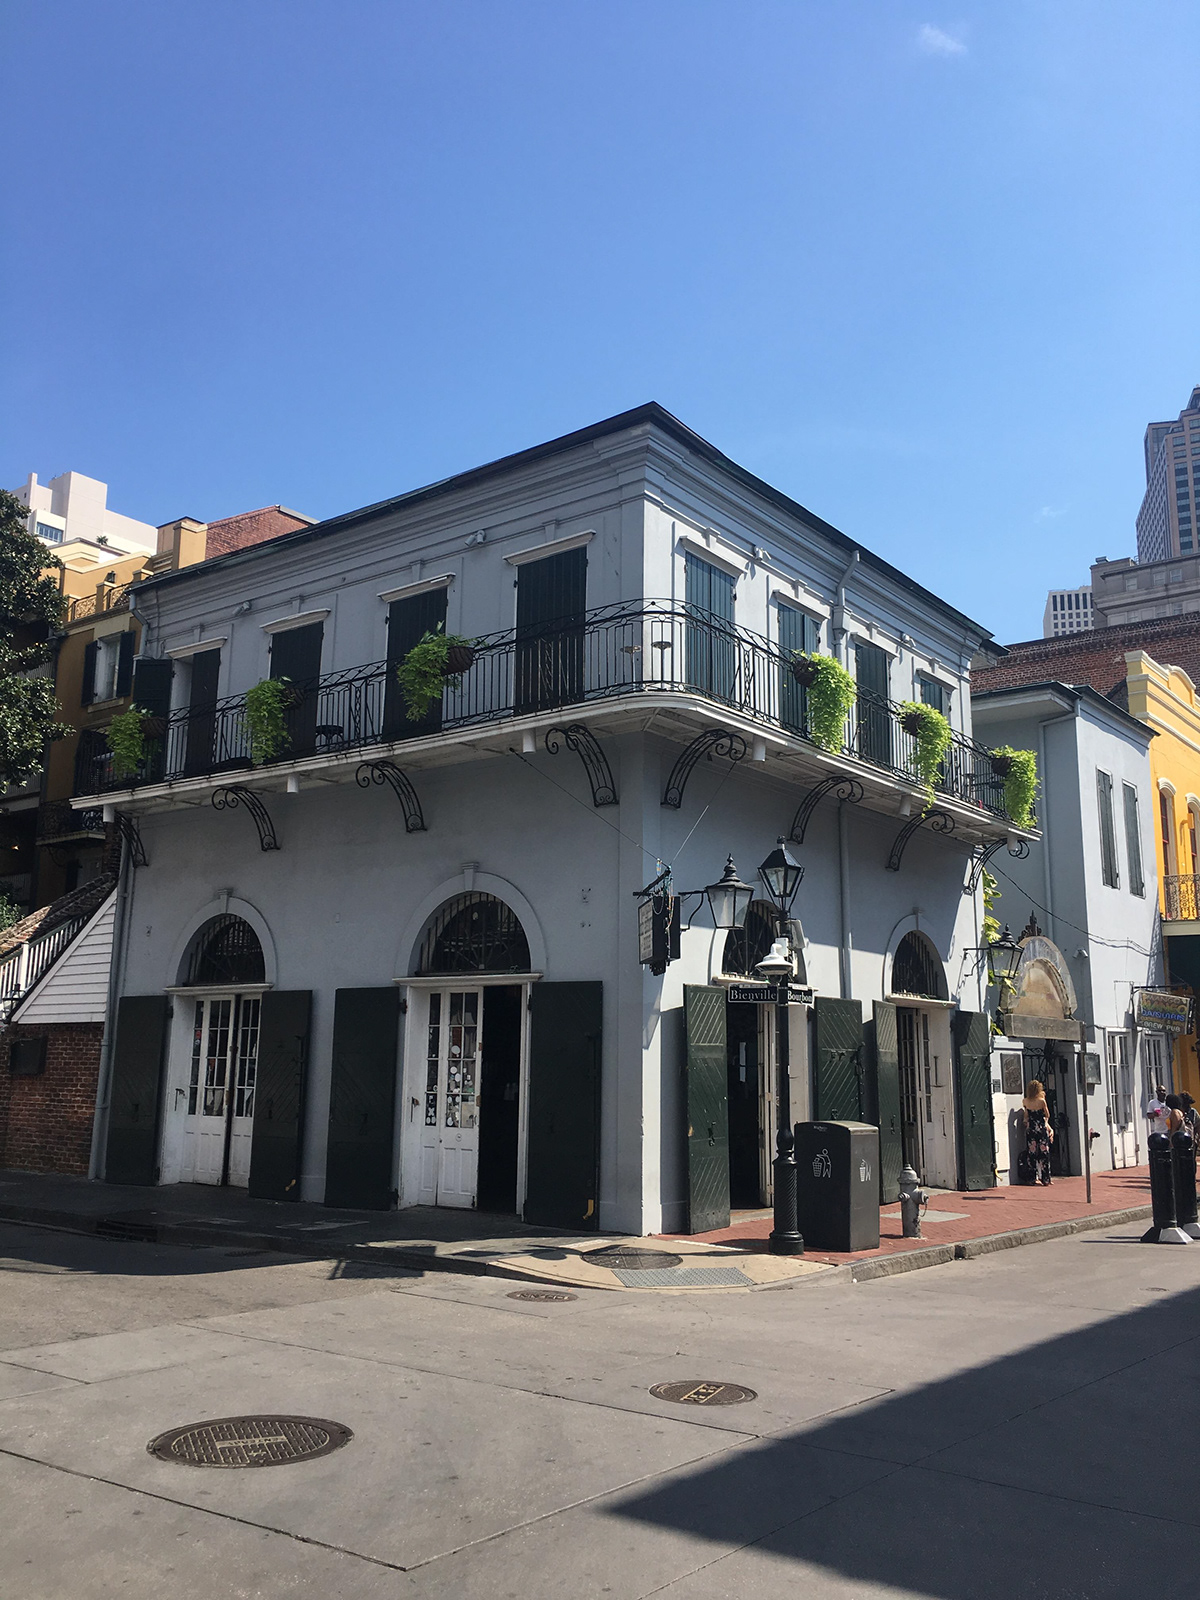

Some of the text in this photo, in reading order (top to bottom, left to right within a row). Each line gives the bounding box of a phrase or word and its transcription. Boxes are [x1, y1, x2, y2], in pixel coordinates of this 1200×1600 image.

[731, 989, 777, 1000] Bienville
[788, 991, 812, 1002] Bourbon
[1144, 1021, 1163, 1029] BREW
[1166, 1024, 1181, 1032] PUB
